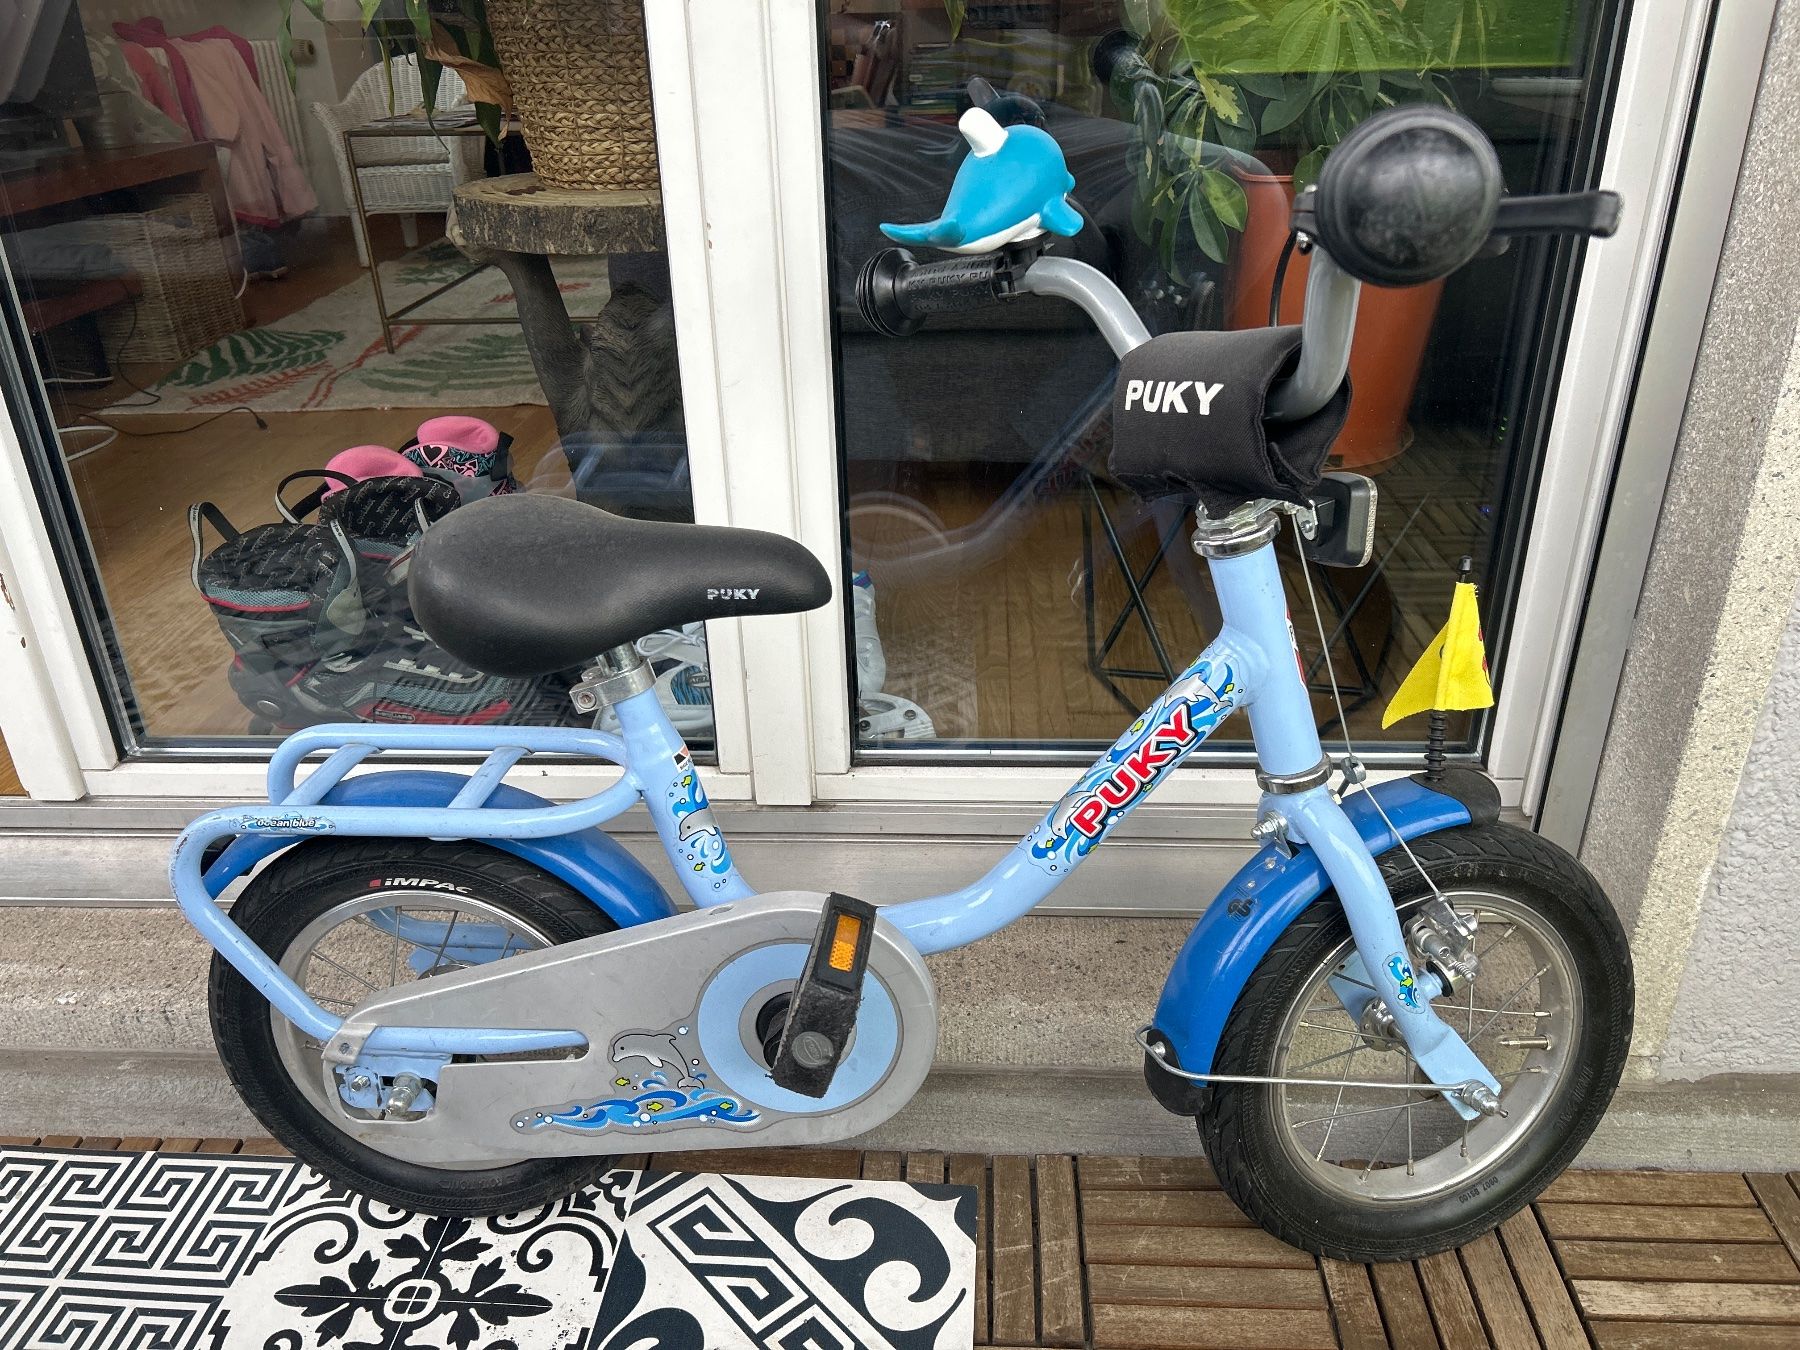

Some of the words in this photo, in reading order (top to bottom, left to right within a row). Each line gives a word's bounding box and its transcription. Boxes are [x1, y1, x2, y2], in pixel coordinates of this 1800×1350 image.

[1125, 380, 1225, 416] PUKY
[707, 588, 761, 600] PUKY
[1070, 704, 1197, 838] PUKY
[256, 818, 291, 828] ocean
[292, 817, 316, 828] blue
